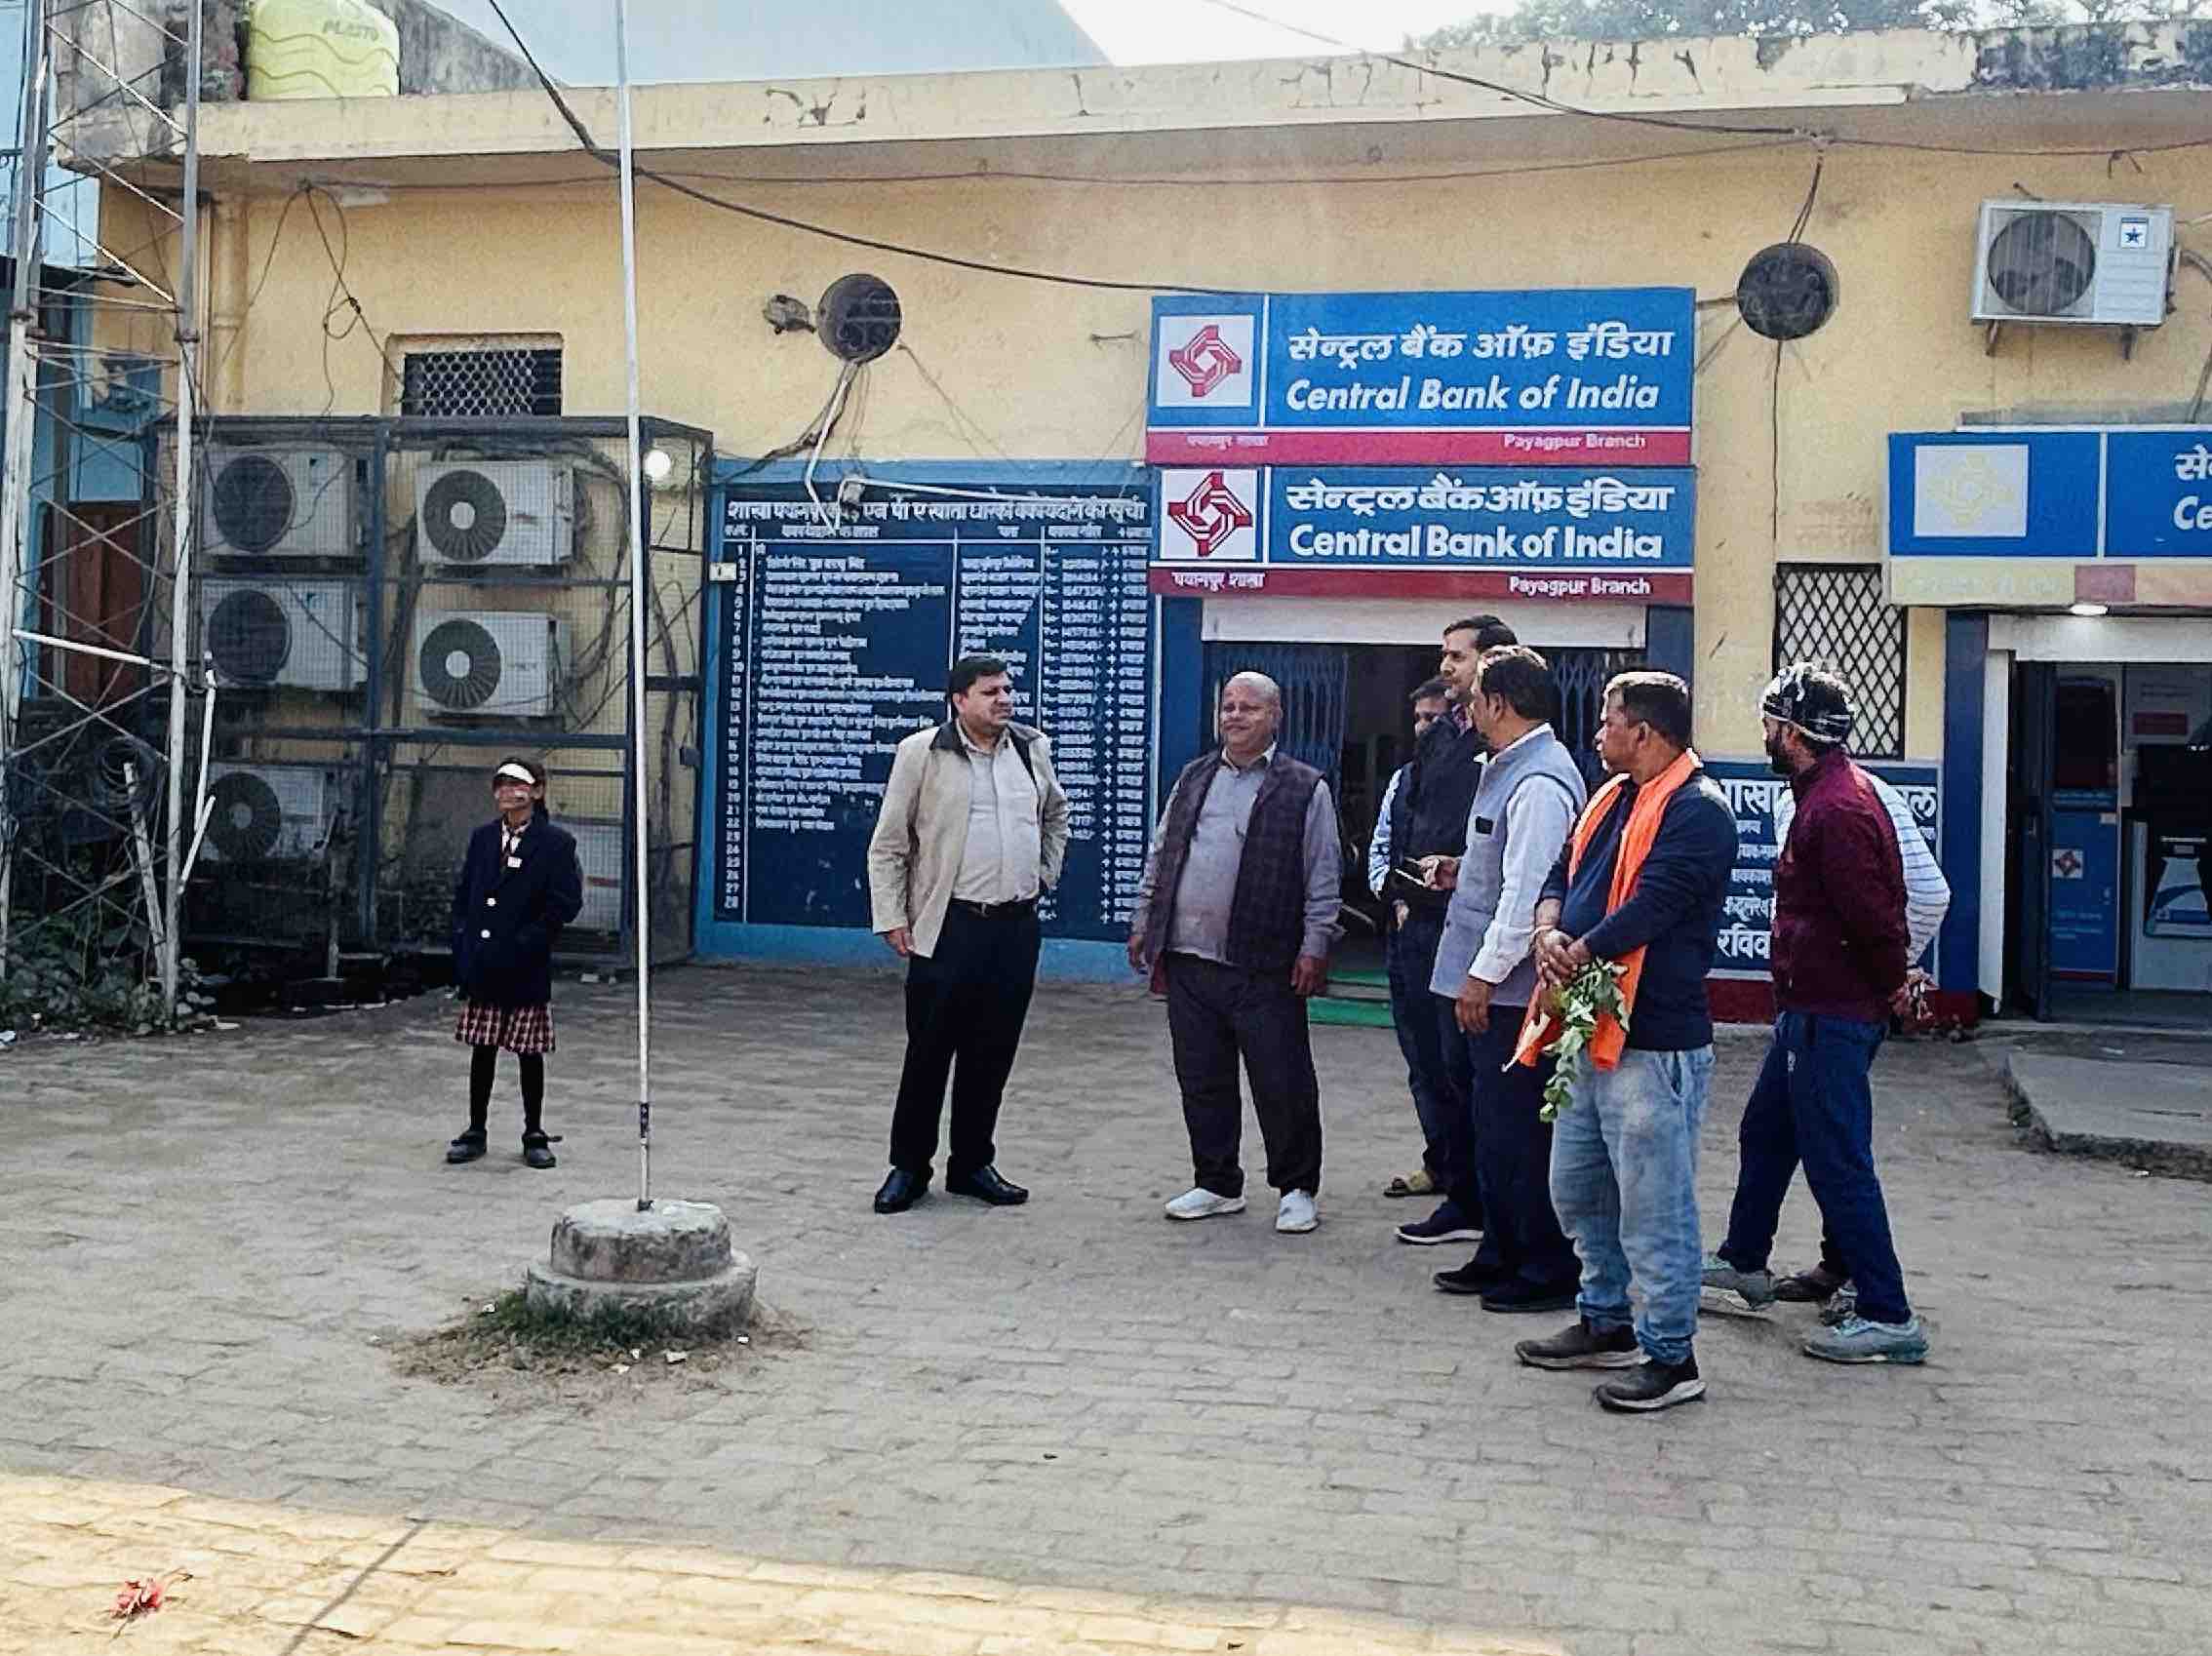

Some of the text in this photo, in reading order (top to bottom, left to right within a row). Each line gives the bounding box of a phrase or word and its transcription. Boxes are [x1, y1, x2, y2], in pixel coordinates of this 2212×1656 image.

[1288, 326, 1396, 370] सेन्ट्रल
[1401, 323, 1467, 358] बैंक
[1566, 321, 1675, 360] इंडिया
[1286, 375, 1659, 411] Central Bank of India
[1504, 433, 1646, 452] Payagpur Branch
[1286, 478, 1418, 517] सेन्ट्रल
[1418, 472, 1485, 510] बैंक
[1565, 476, 1676, 518] इंडिया
[1289, 523, 1662, 559] Central Bank of India
[1510, 576, 1650, 597] Payagpur Branch
[1720, 778, 1787, 814] ाखा
[1717, 923, 1772, 960] रविव
